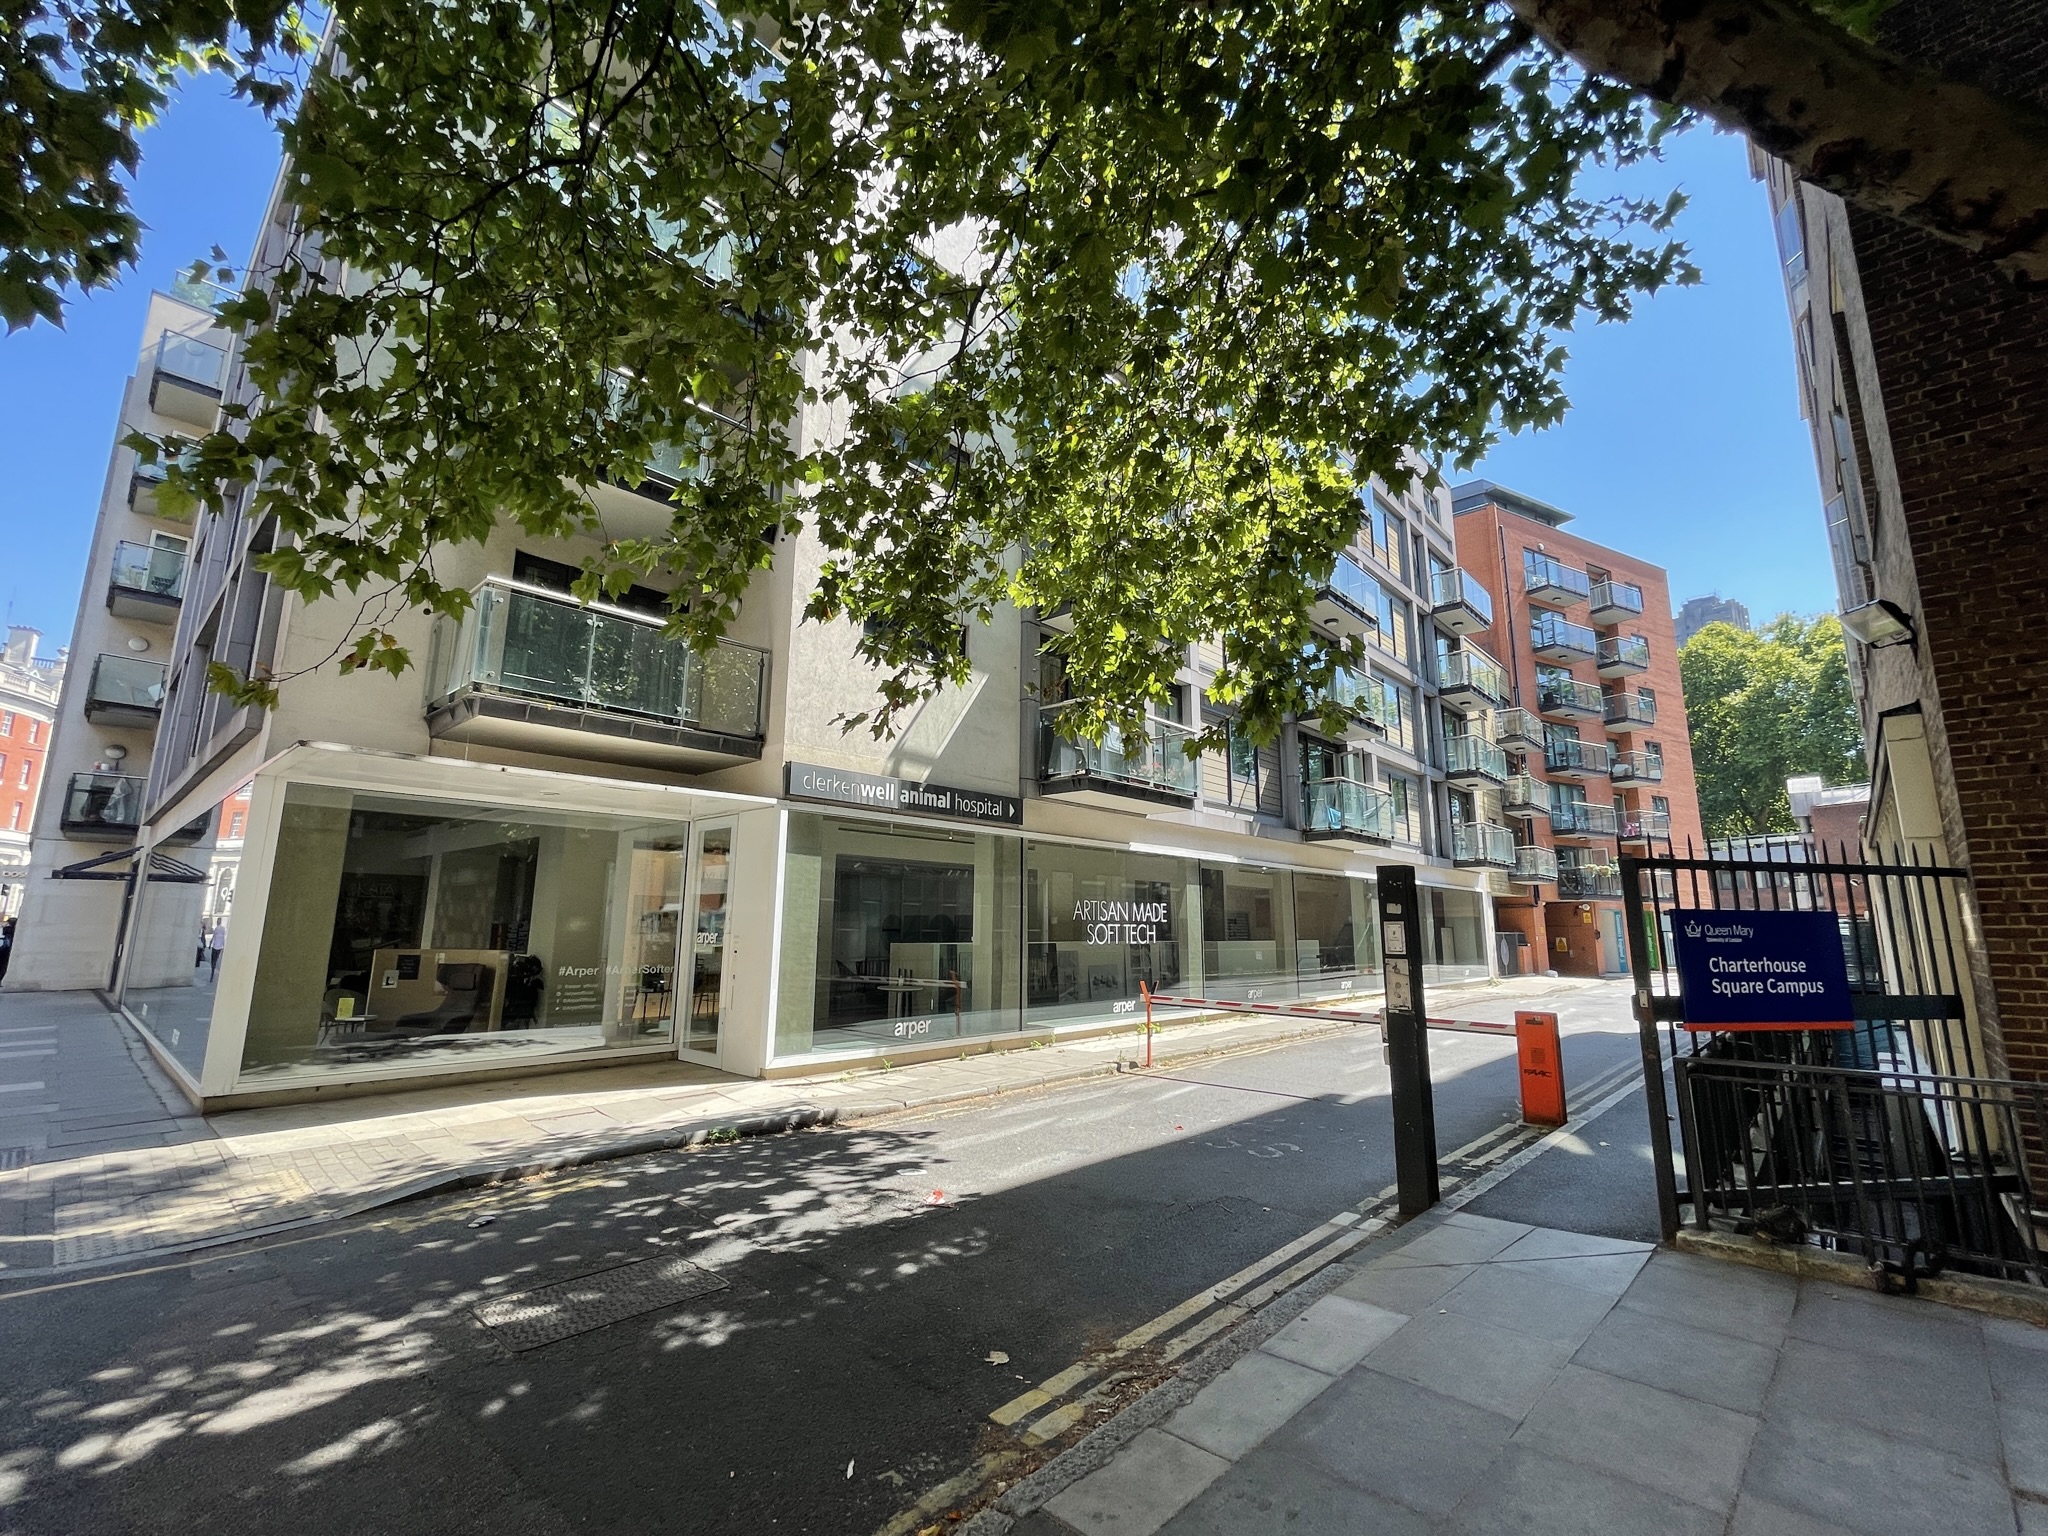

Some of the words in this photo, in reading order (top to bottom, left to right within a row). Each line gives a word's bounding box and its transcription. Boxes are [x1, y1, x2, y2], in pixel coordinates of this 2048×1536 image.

[803, 770, 895, 801] clerkenwell
[900, 788, 950, 809] animal
[955, 797, 1002, 817] hospital
[1073, 900, 1129, 921] ARTISAN
[1132, 902, 1168, 922] MADE
[696, 932, 718, 947] arper
[1087, 923, 1120, 945] SOFT
[1123, 924, 1156, 944] TECH
[1704, 924, 1732, 936] Queen
[1732, 924, 1753, 938] Mary
[558, 965, 600, 978] #Arper
[1709, 956, 1806, 973] Charterhouse
[1247, 988, 1263, 1000] arper
[1711, 978, 1764, 998] Square
[1766, 978, 1824, 997] Campus
[1112, 1000, 1136, 1014] arper
[894, 1020, 932, 1039] arper
